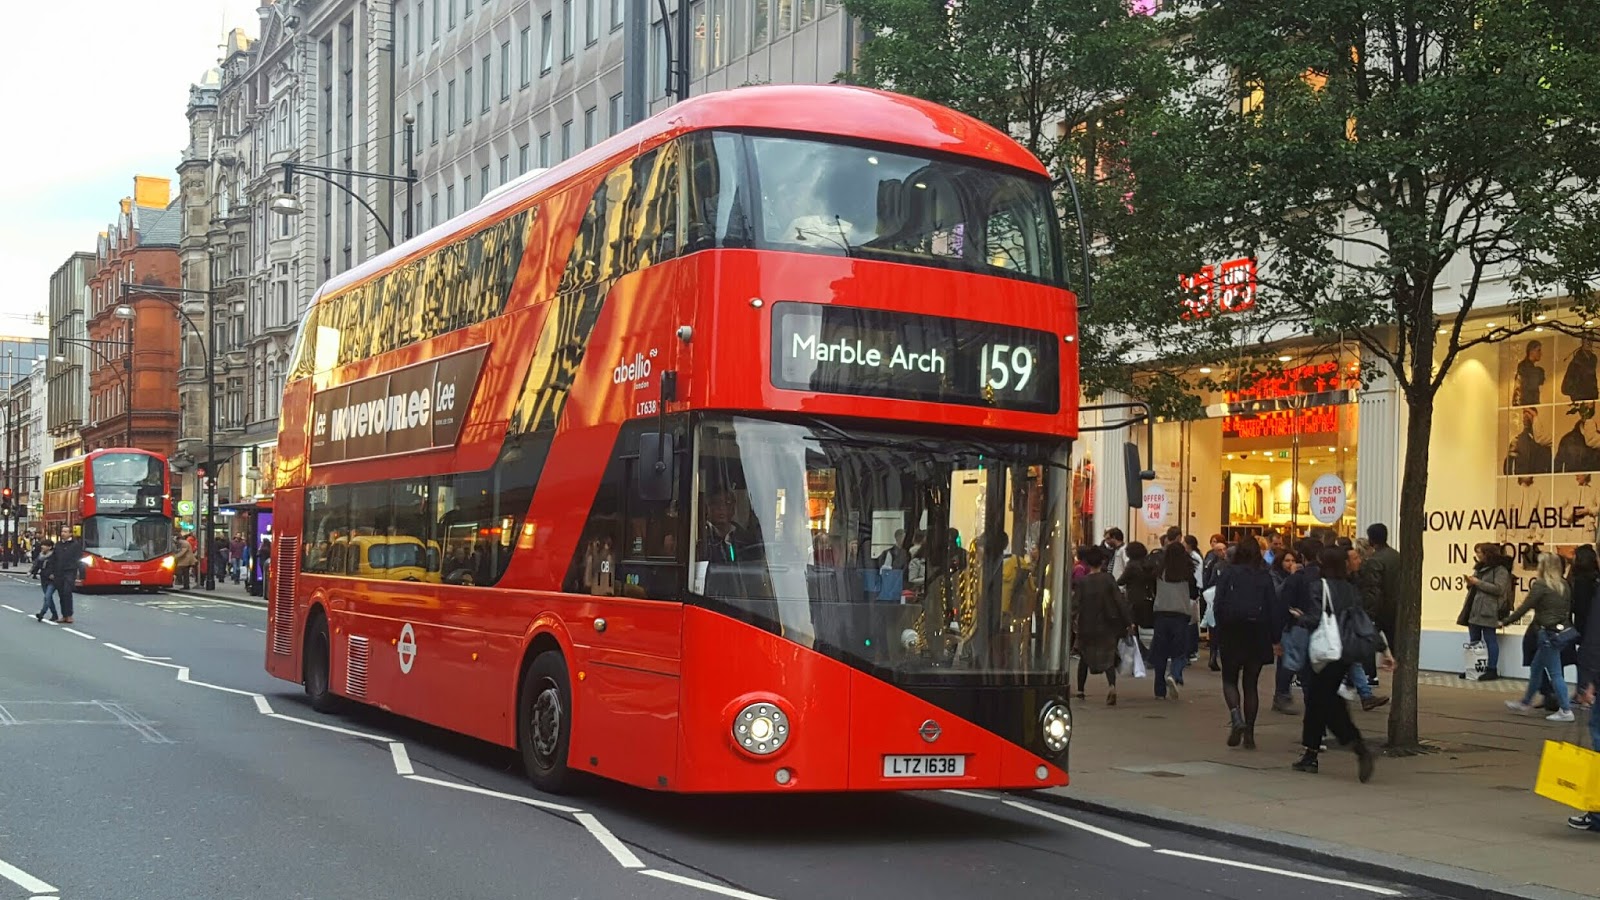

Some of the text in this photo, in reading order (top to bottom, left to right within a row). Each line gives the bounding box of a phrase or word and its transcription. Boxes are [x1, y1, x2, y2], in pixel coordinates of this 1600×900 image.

[613, 353, 651, 384] abellio
[793, 333, 1033, 392] Marble Arch 159
[436, 381, 455, 412] Lee
[636, 400, 657, 416] LT638
[314, 411, 326, 437] Lee
[1144, 494, 1165, 502] OFFERS
[1314, 485, 1342, 496] OFFERS
[145, 496, 156, 507] 13
[1147, 502, 1161, 511] FROM
[1319, 496, 1337, 505] FROM
[1468, 506, 1585, 530] AVAILABLE
[1448, 543, 1468, 564] IN
[1430, 576, 1452, 591] ON
